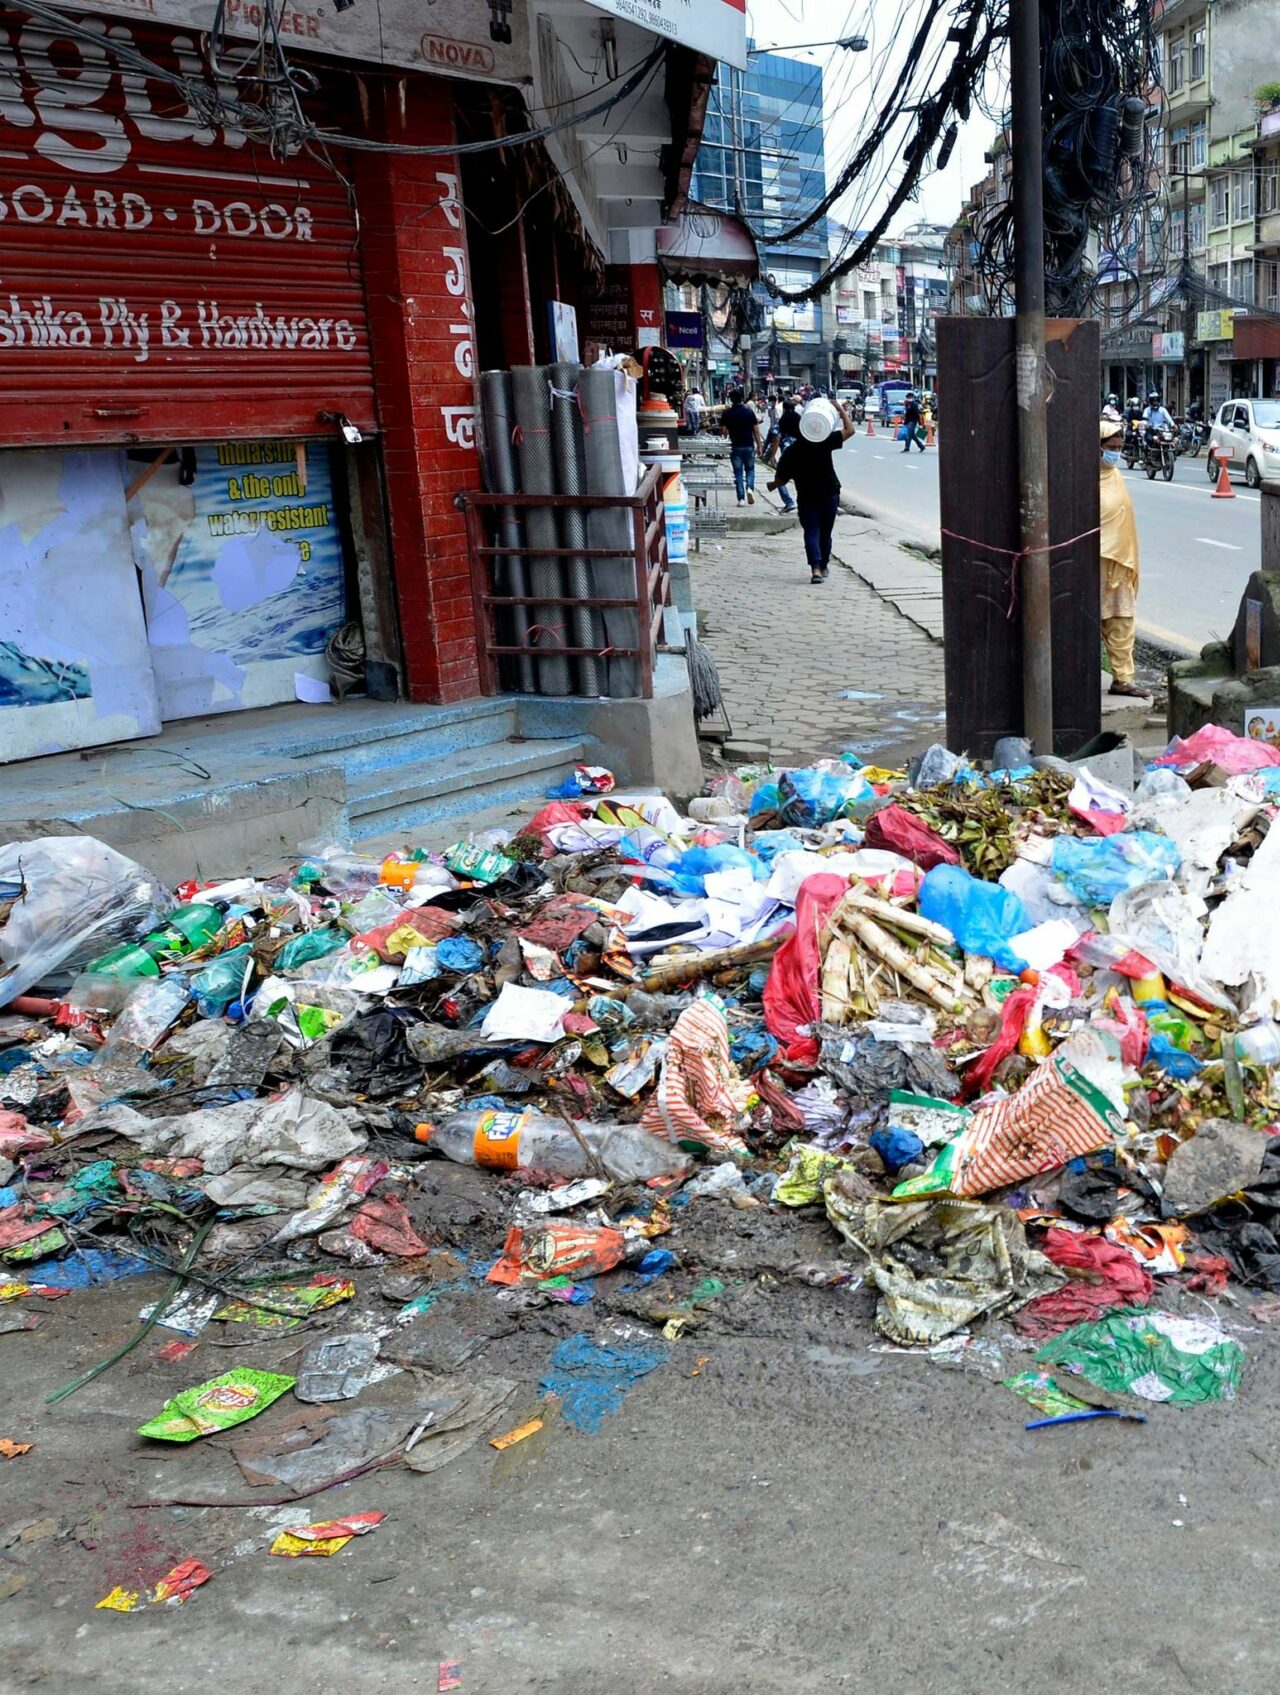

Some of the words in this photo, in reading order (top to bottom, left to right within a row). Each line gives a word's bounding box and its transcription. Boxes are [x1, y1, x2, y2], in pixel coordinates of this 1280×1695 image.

[428, 38, 487, 69] NOVA
[193, 199, 317, 241] DOOR
[100, 297, 148, 362] Ply
[161, 300, 190, 348] &
[198, 300, 356, 351] Hardware
[679, 327, 698, 335] Ncell
[228, 477, 242, 501] &
[242, 473, 271, 499] the
[272, 470, 307, 499] only
[208, 510, 258, 537] water
[260, 503, 329, 531] resistant
